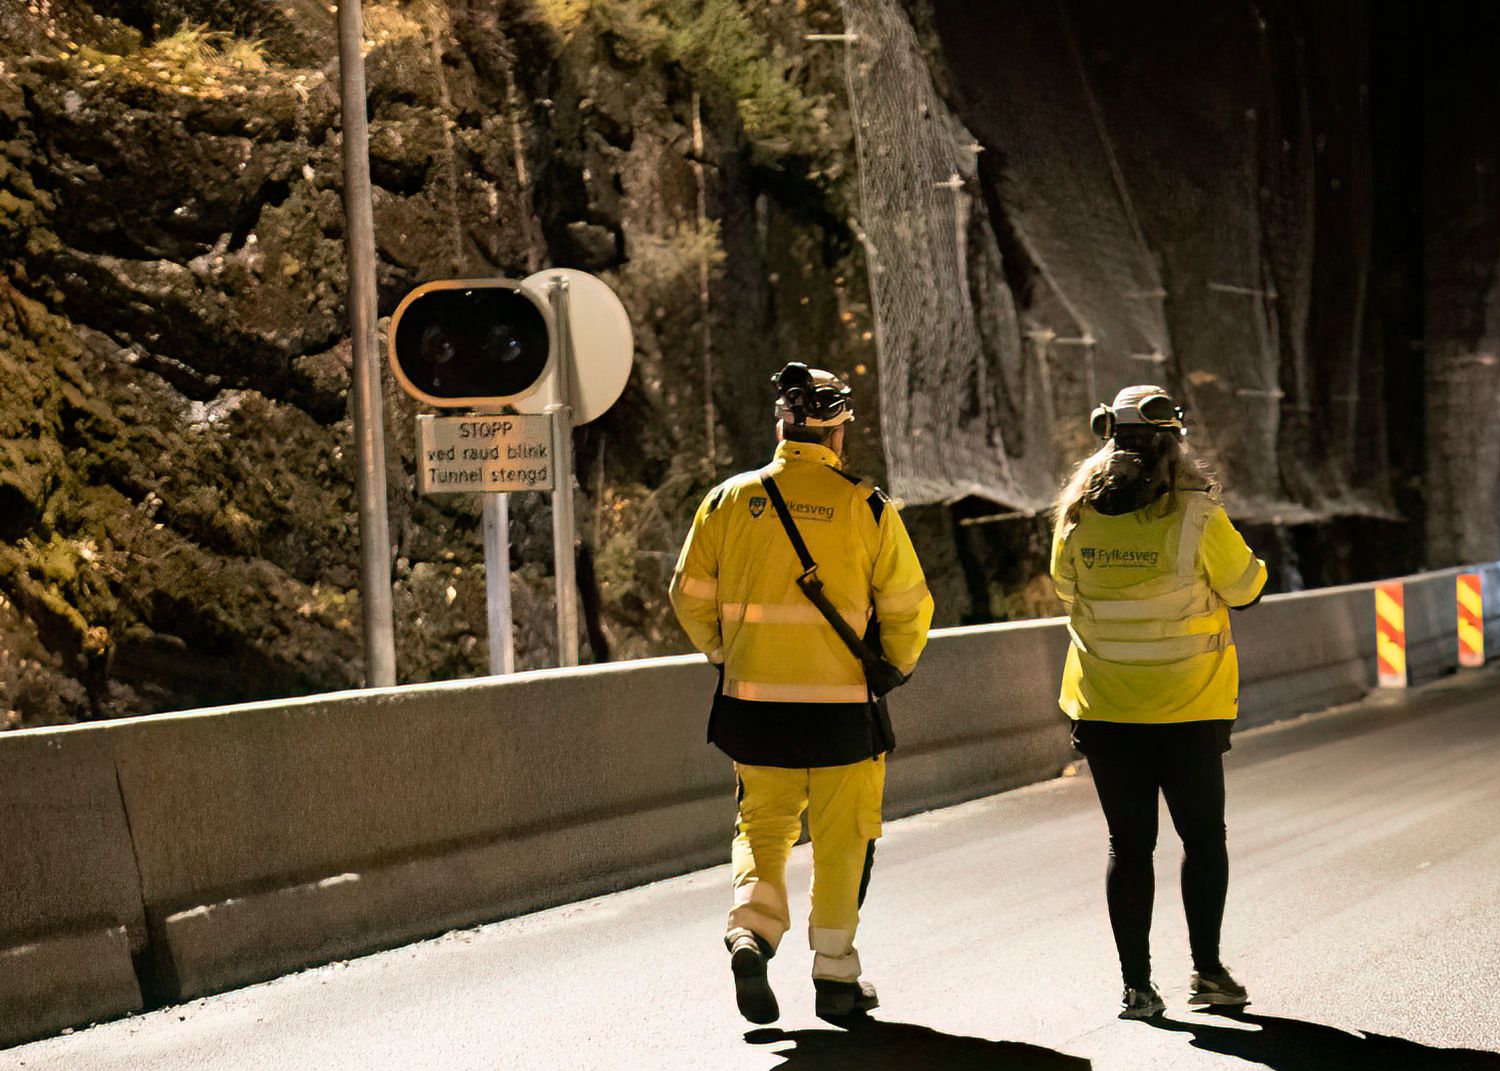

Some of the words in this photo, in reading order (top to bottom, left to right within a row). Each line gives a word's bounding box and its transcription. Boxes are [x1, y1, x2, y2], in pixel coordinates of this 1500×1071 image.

[459, 420, 514, 438] STOPP
[427, 445, 456, 460] ved
[462, 444, 500, 460] raud
[507, 442, 548, 459] blink
[429, 466, 484, 483] Tunnel
[490, 464, 548, 485] stengd
[1098, 548, 1159, 565] Fylkesveg
